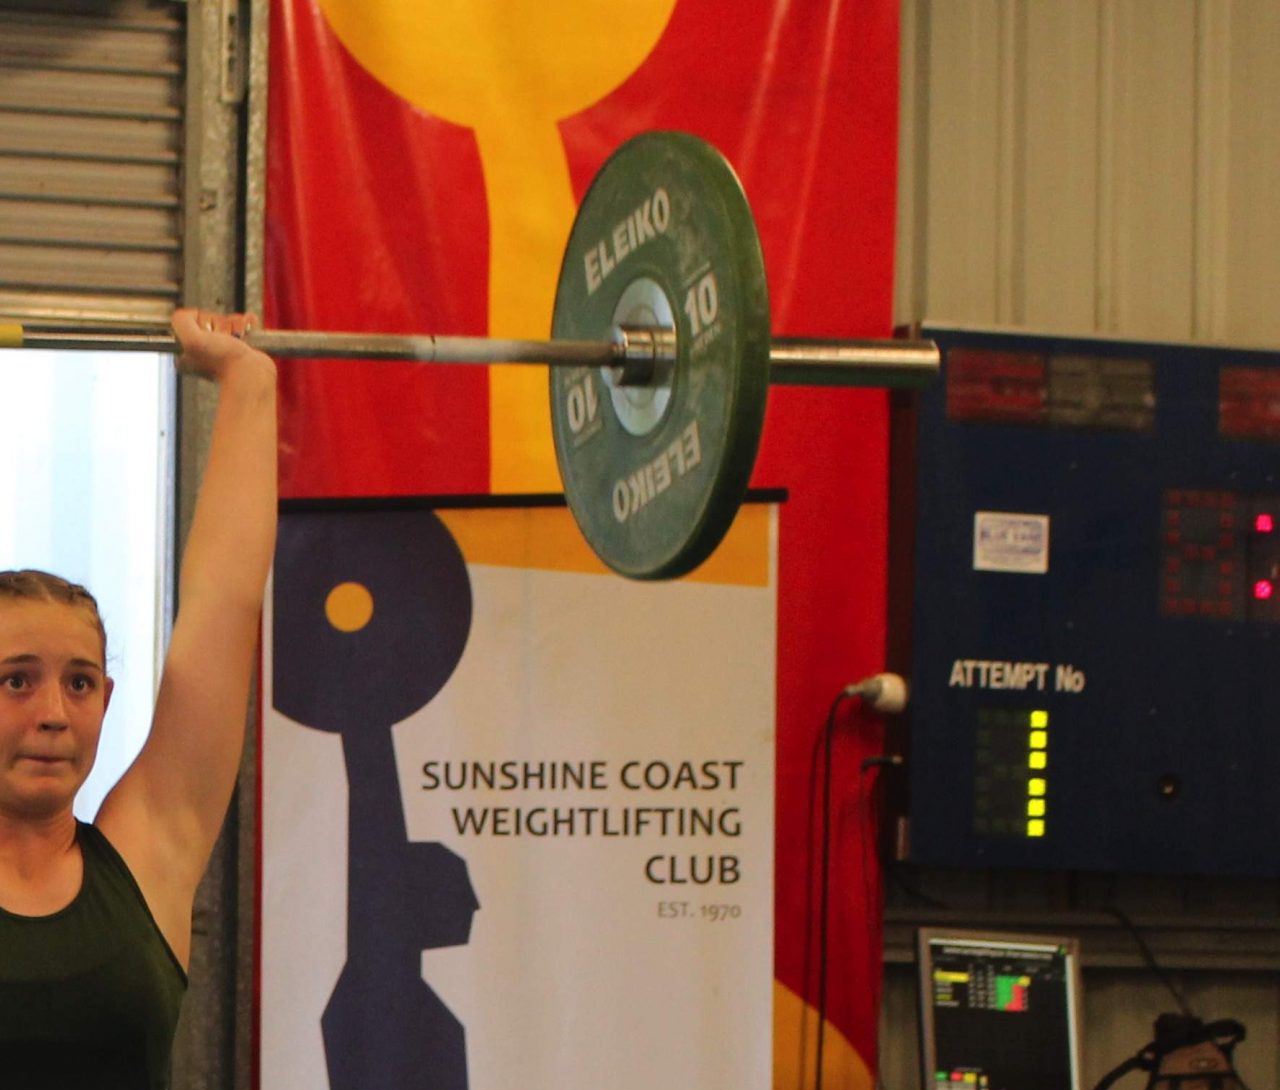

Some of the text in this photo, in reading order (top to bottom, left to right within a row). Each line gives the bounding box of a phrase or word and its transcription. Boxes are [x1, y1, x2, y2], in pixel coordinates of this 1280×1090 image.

[584, 187, 671, 296] ELEIKO
[684, 271, 718, 337] 10
[567, 374, 597, 433] 10
[612, 420, 701, 523] ELEIKO
[949, 659, 1086, 693] ATTEMPT No
[421, 761, 744, 790] SUNSHINE COAST
[451, 807, 742, 837] WEIGHTLIFTING
[644, 855, 742, 884] CLUB
[657, 902, 742, 922] EST. 1970
